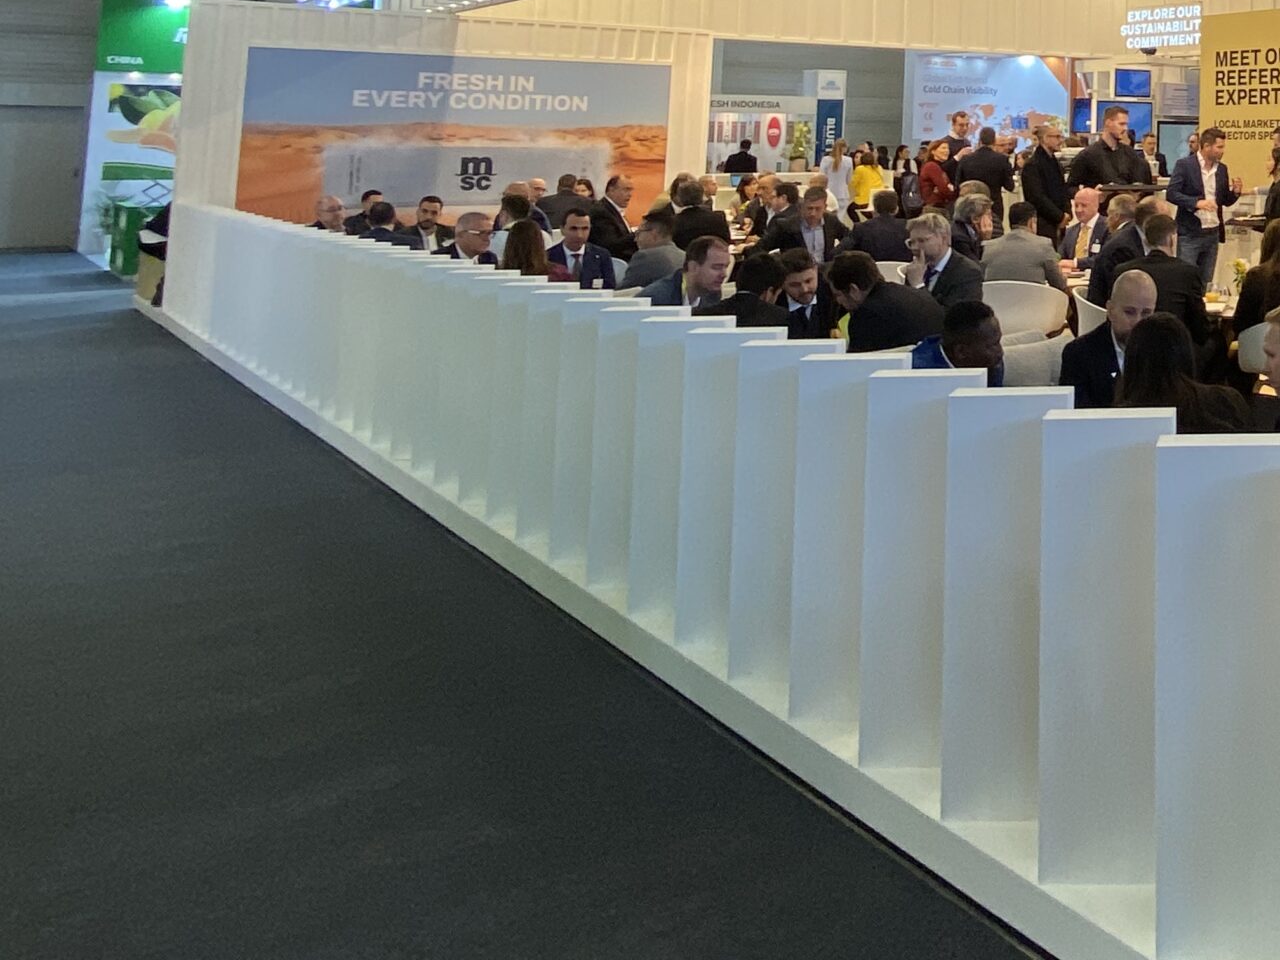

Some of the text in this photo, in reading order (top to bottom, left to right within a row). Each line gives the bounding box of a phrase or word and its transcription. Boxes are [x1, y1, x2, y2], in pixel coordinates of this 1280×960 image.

[1127, 5, 1200, 22] EXPLORE OUR
[1120, 19, 1201, 37] SUSTAINABILIT
[1126, 33, 1201, 49] COMMITMENT
[1215, 49, 1261, 67] MEET
[417, 72, 535, 92] FRESH IN
[1215, 68, 1280, 86] REEFER
[923, 85, 941, 93] Cold
[942, 85, 964, 94] Chain
[352, 90, 588, 112] EVERY CONDITION
[731, 100, 780, 109] INDONESIA
[1214, 120, 1242, 128] LOCAL
[1226, 131, 1256, 140] ECTOR
